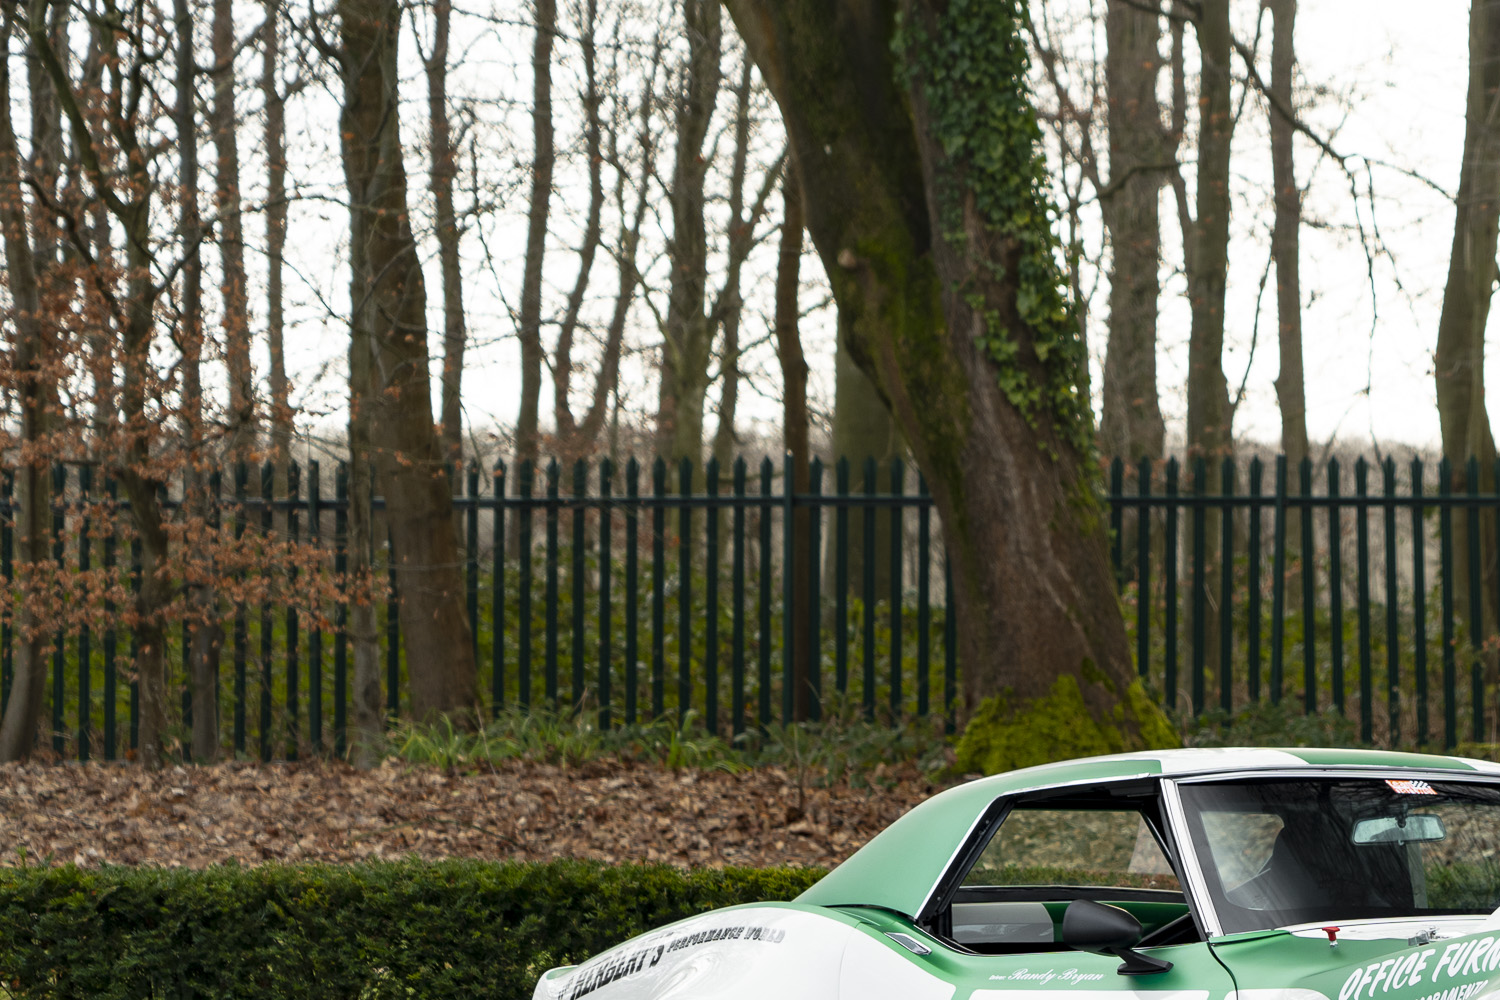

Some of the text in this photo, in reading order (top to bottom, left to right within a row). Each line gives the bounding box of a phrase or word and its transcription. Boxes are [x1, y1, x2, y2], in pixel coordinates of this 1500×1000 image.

[666, 926, 745, 953] PERFORMANCE
[1007, 968, 1057, 985] Randy
[1057, 968, 1105, 985] Bryan
